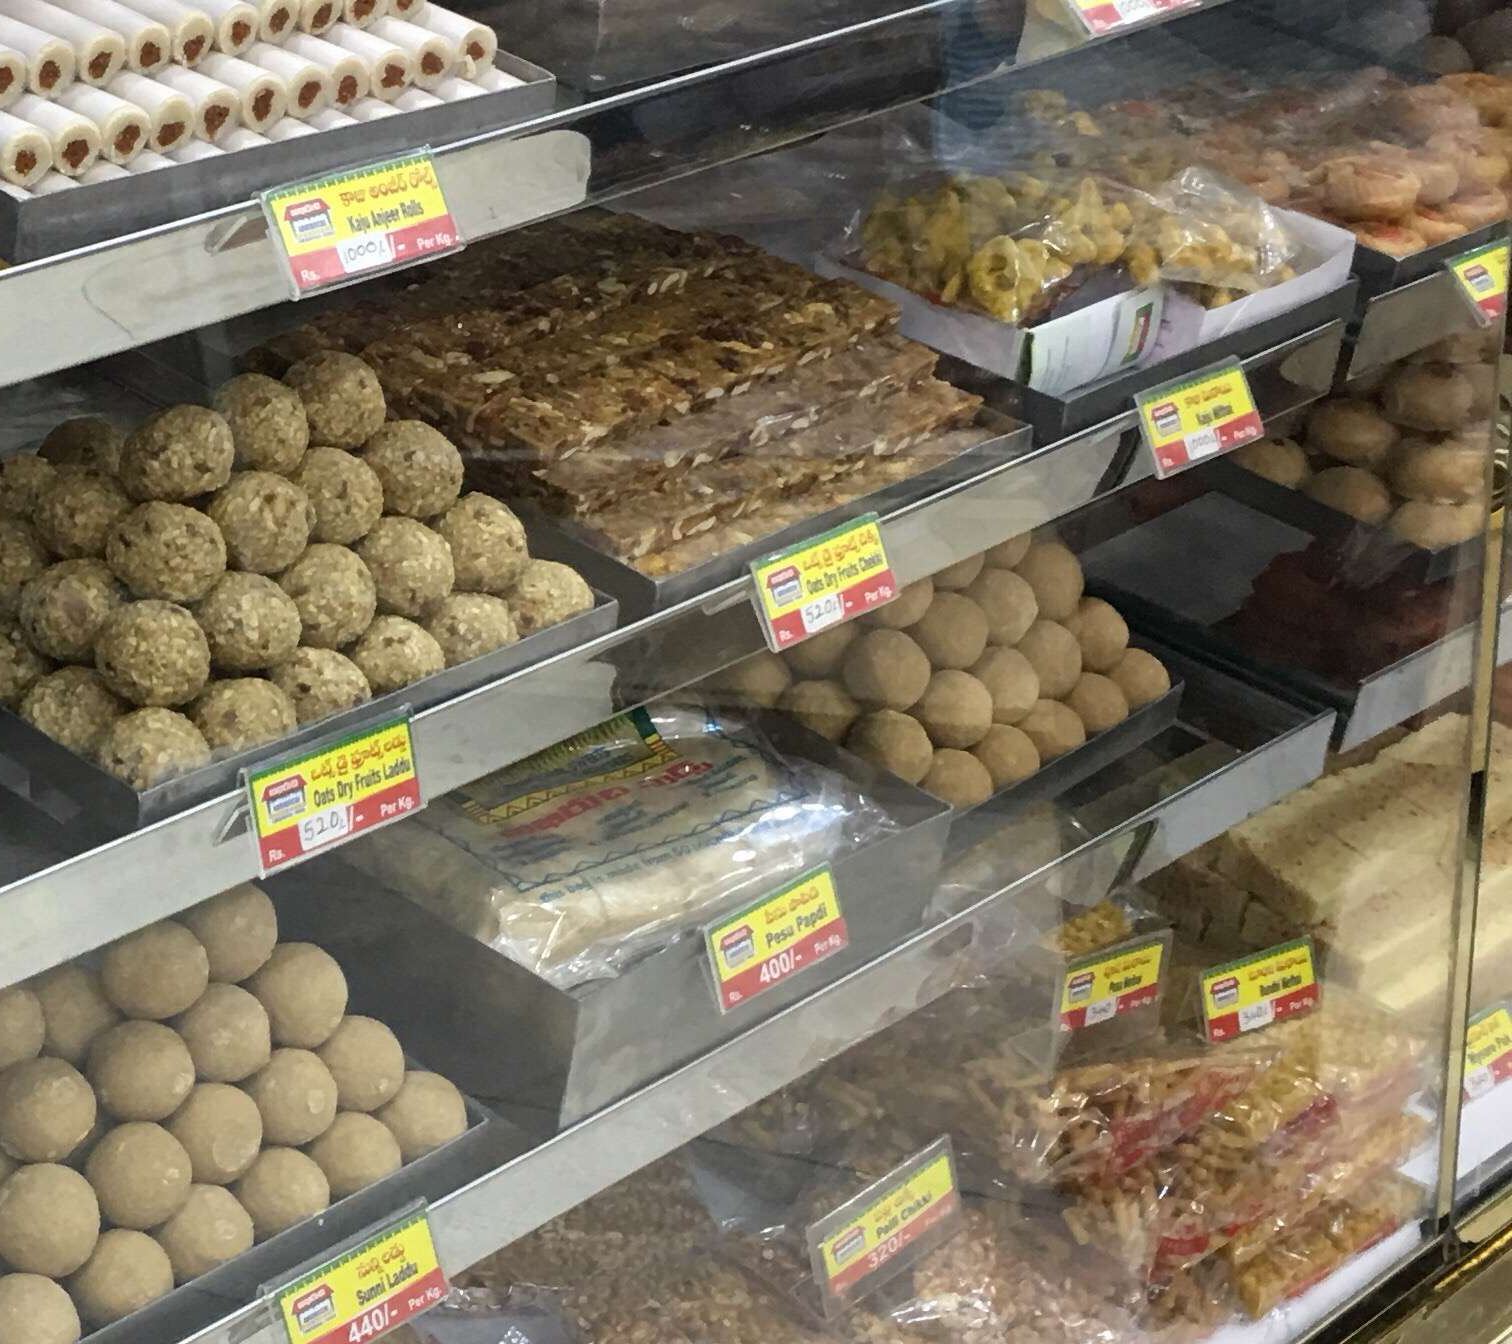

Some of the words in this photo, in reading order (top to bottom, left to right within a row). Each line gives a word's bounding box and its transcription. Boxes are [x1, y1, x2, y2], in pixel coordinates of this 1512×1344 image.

[347, 215, 371, 234] Kaju
[402, 200, 424, 218] Rolls
[417, 238, 434, 251] Per
[313, 788, 336, 807] Oats
[337, 781, 353, 799] Dry
[355, 769, 382, 791] Fruits
[383, 757, 411, 780] Laddu
[380, 803, 397, 817] Per
[796, 902, 828, 932] Papdi
[760, 949, 802, 984] 400/-
[356, 1276, 386, 1305] Sunni
[386, 1261, 418, 1288] Laddu
[349, 1303, 399, 1343] 440/-
[408, 1295, 425, 1311] Per
